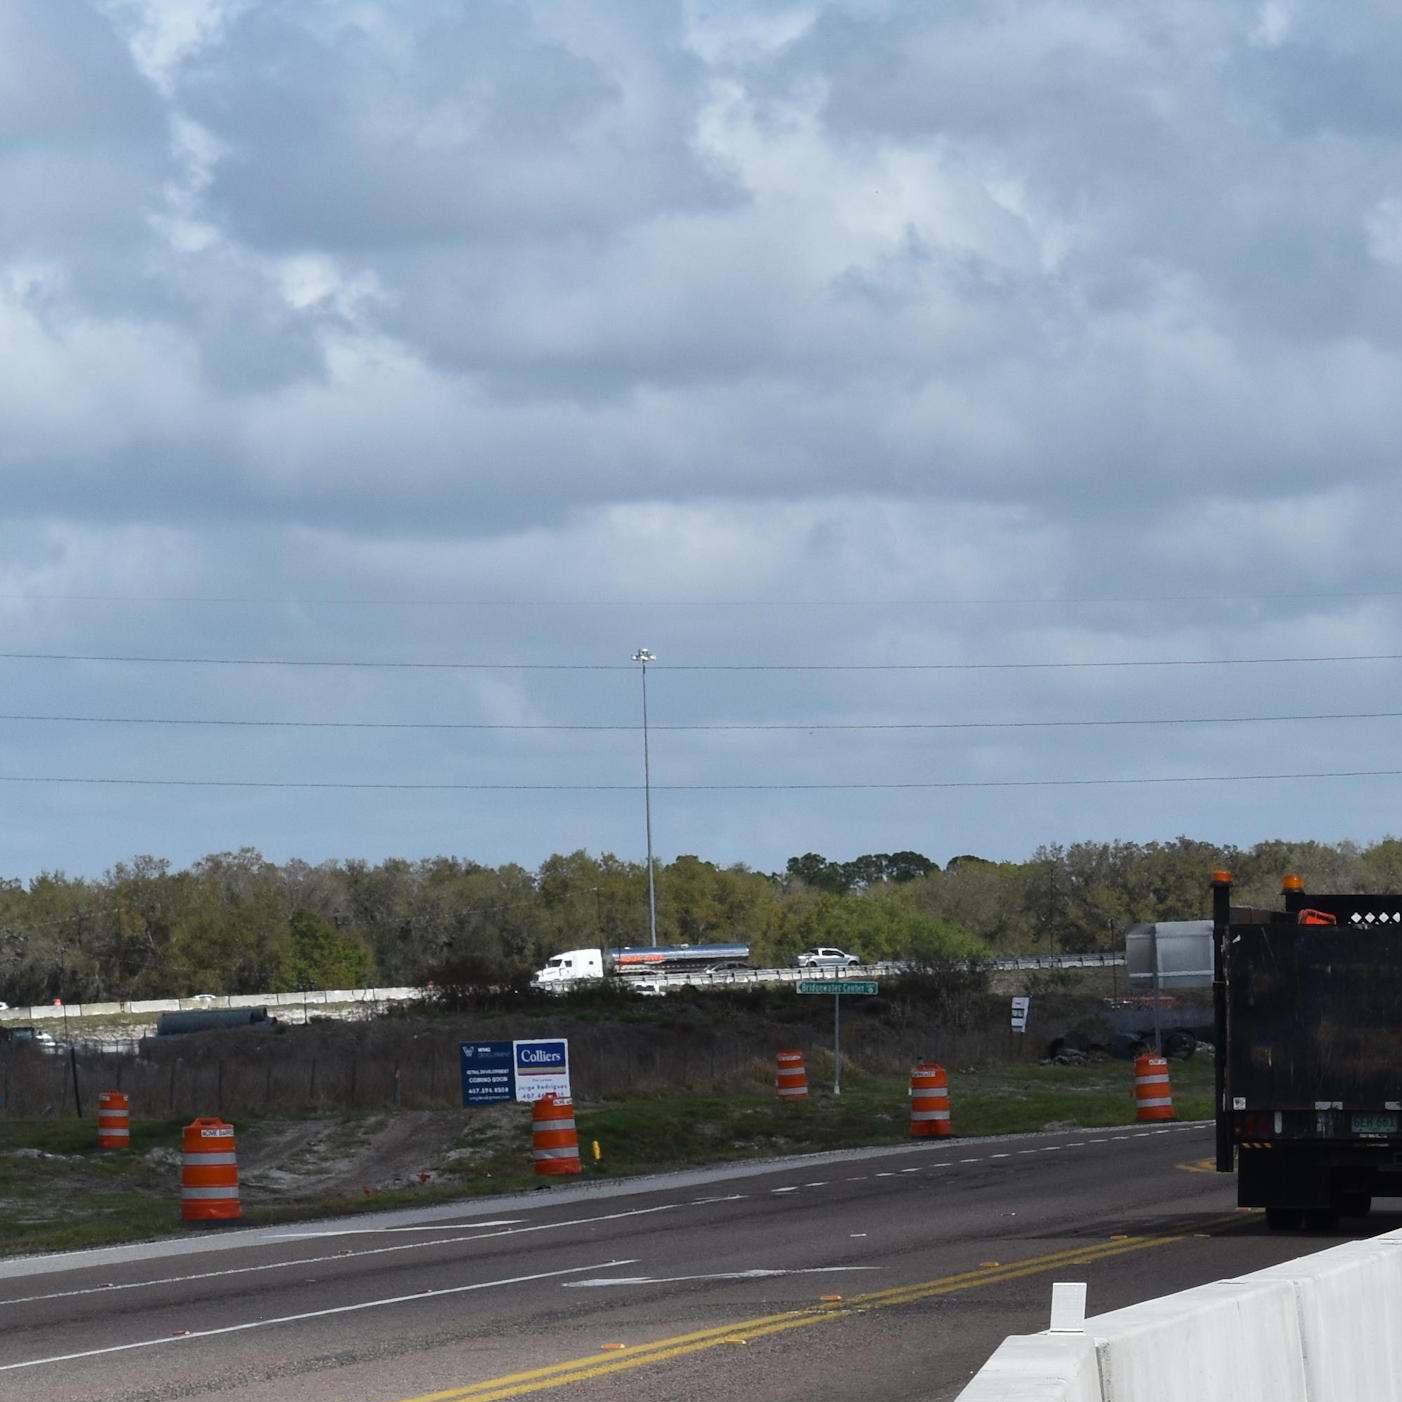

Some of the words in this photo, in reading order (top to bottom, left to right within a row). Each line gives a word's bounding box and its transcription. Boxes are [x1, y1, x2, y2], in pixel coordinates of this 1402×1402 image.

[801, 983, 842, 992] Bridgewater
[843, 983, 865, 992] Center
[521, 1049, 561, 1062] Colliers
